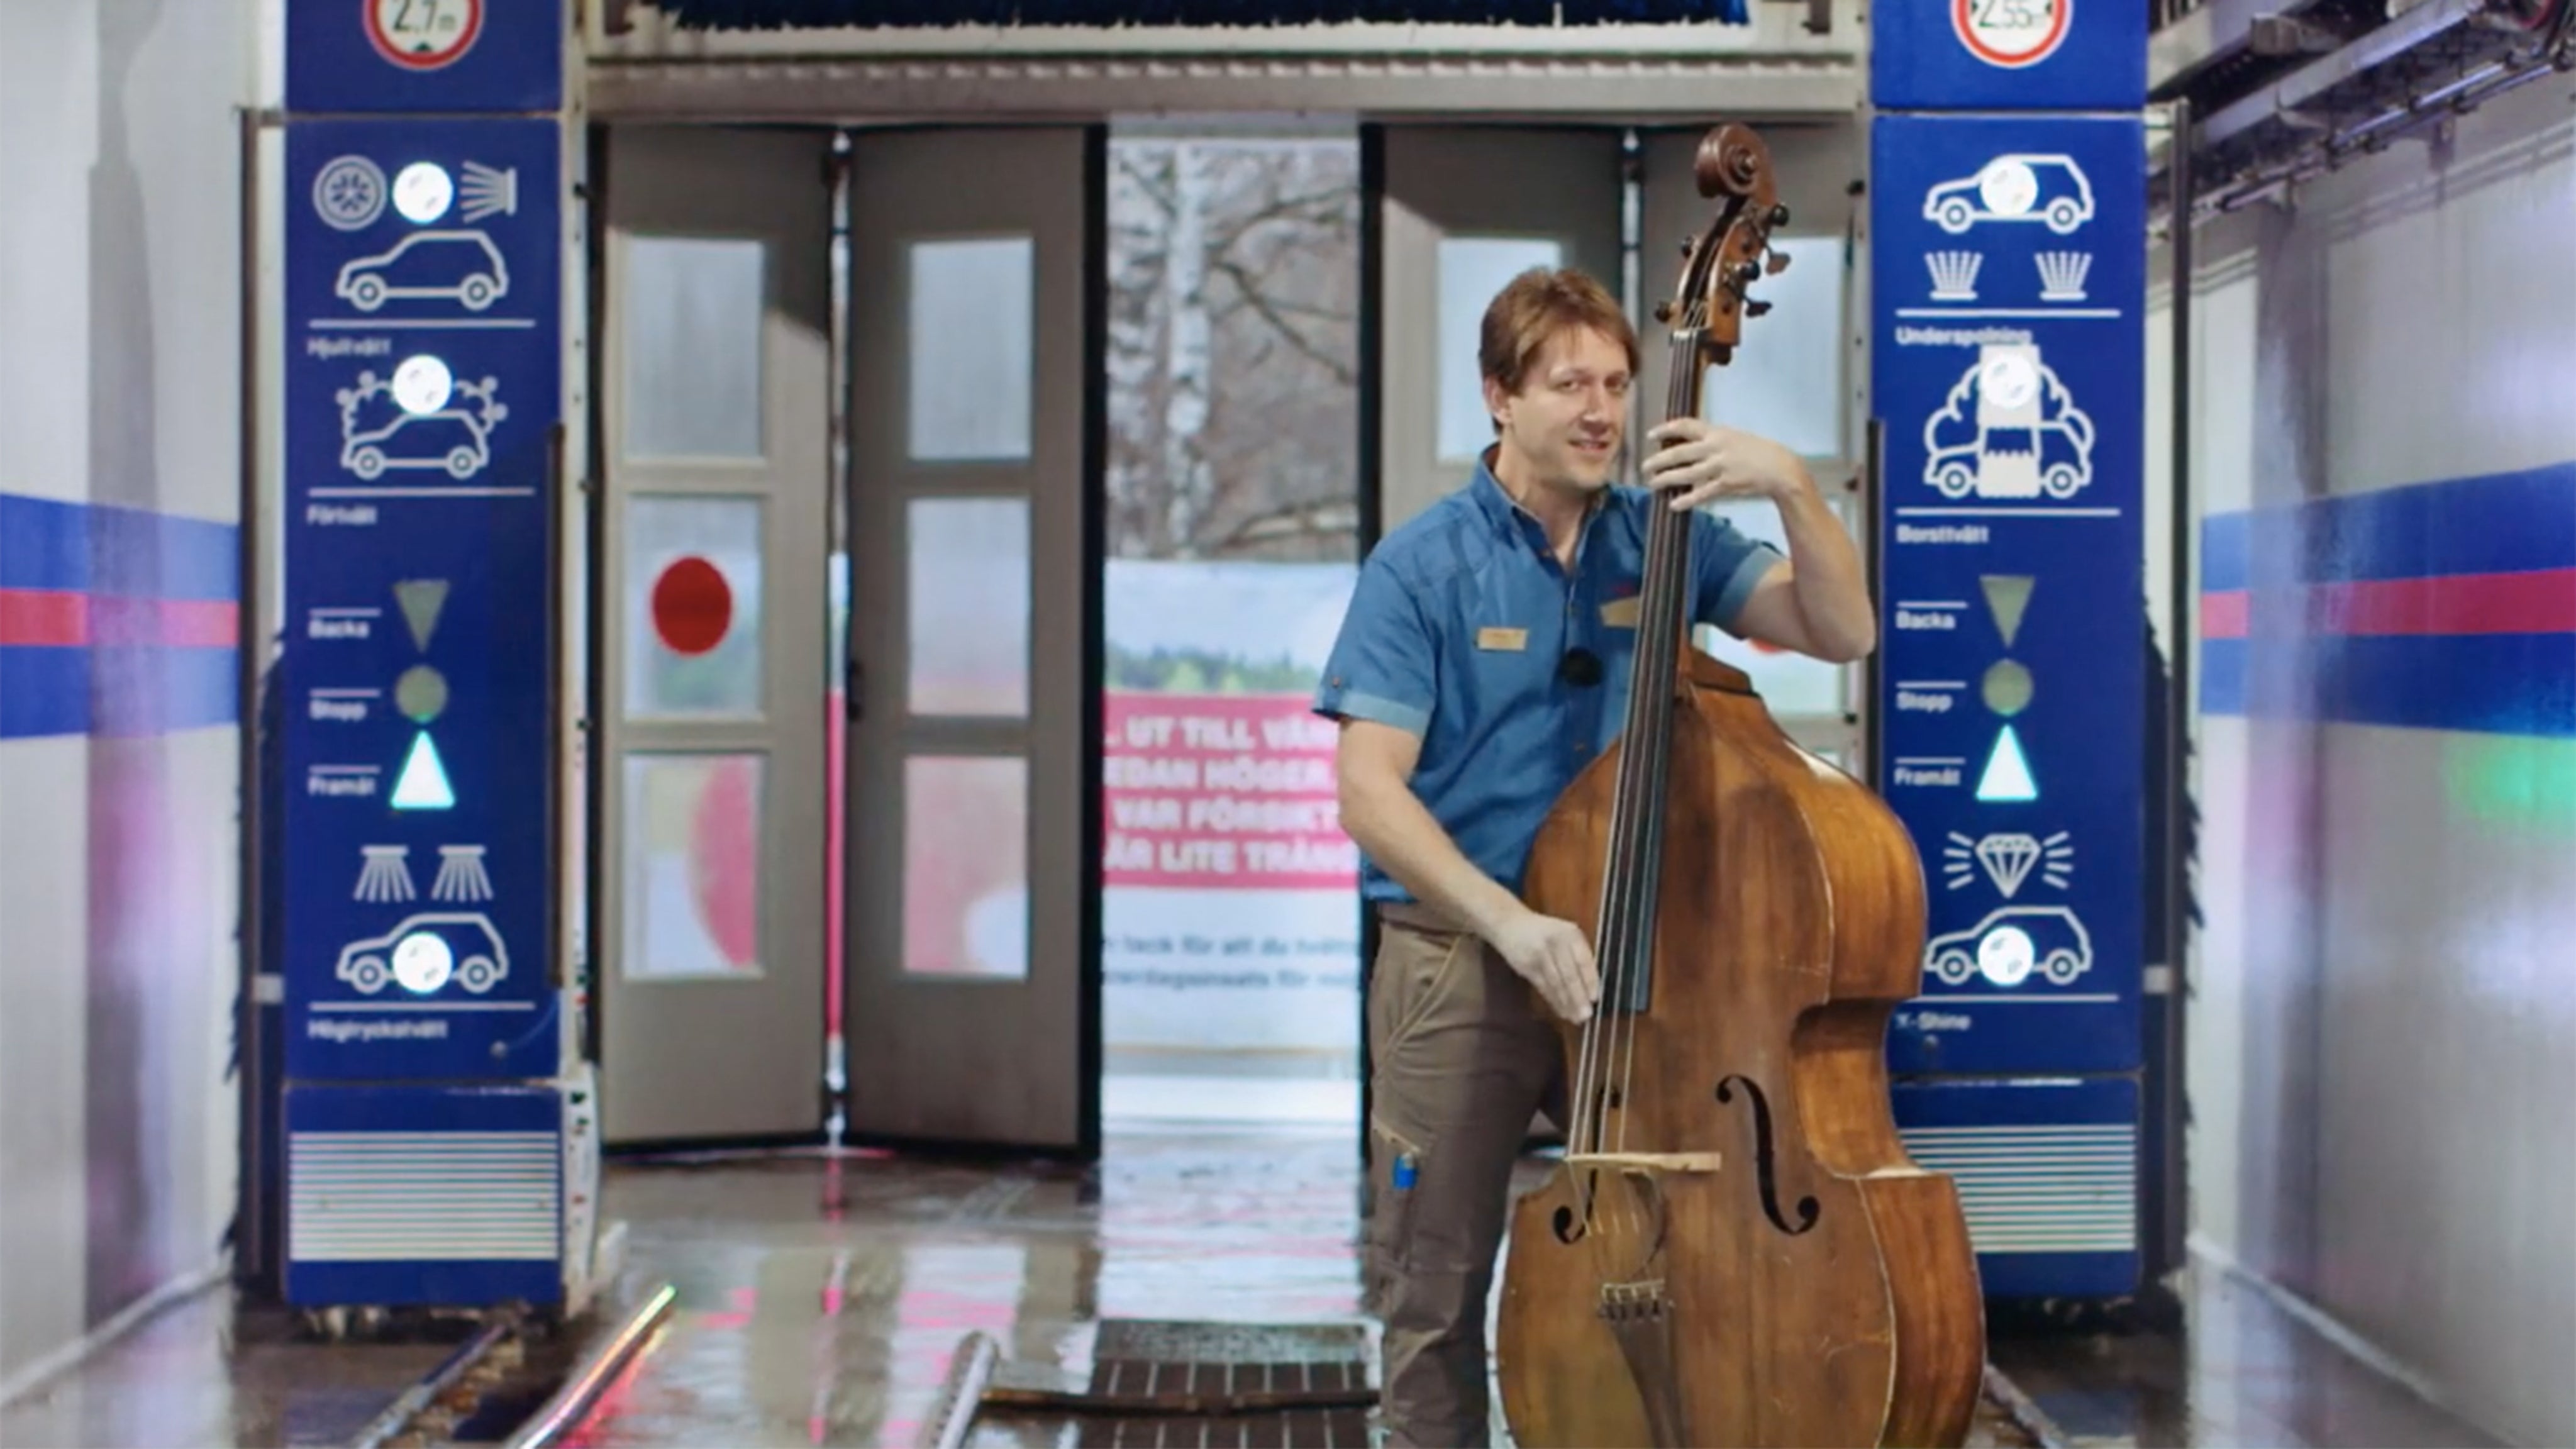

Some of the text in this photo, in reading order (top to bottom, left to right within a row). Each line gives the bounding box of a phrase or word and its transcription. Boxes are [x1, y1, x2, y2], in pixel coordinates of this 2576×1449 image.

[308, 619, 370, 638] Backa
[1896, 610, 1955, 629] Backa
[309, 699, 367, 721] Stopp
[1896, 691, 1953, 713] Stopp
[1179, 717, 1257, 750] TILL
[1112, 798, 1181, 830] VAR
[1160, 840, 1237, 874] LITE
